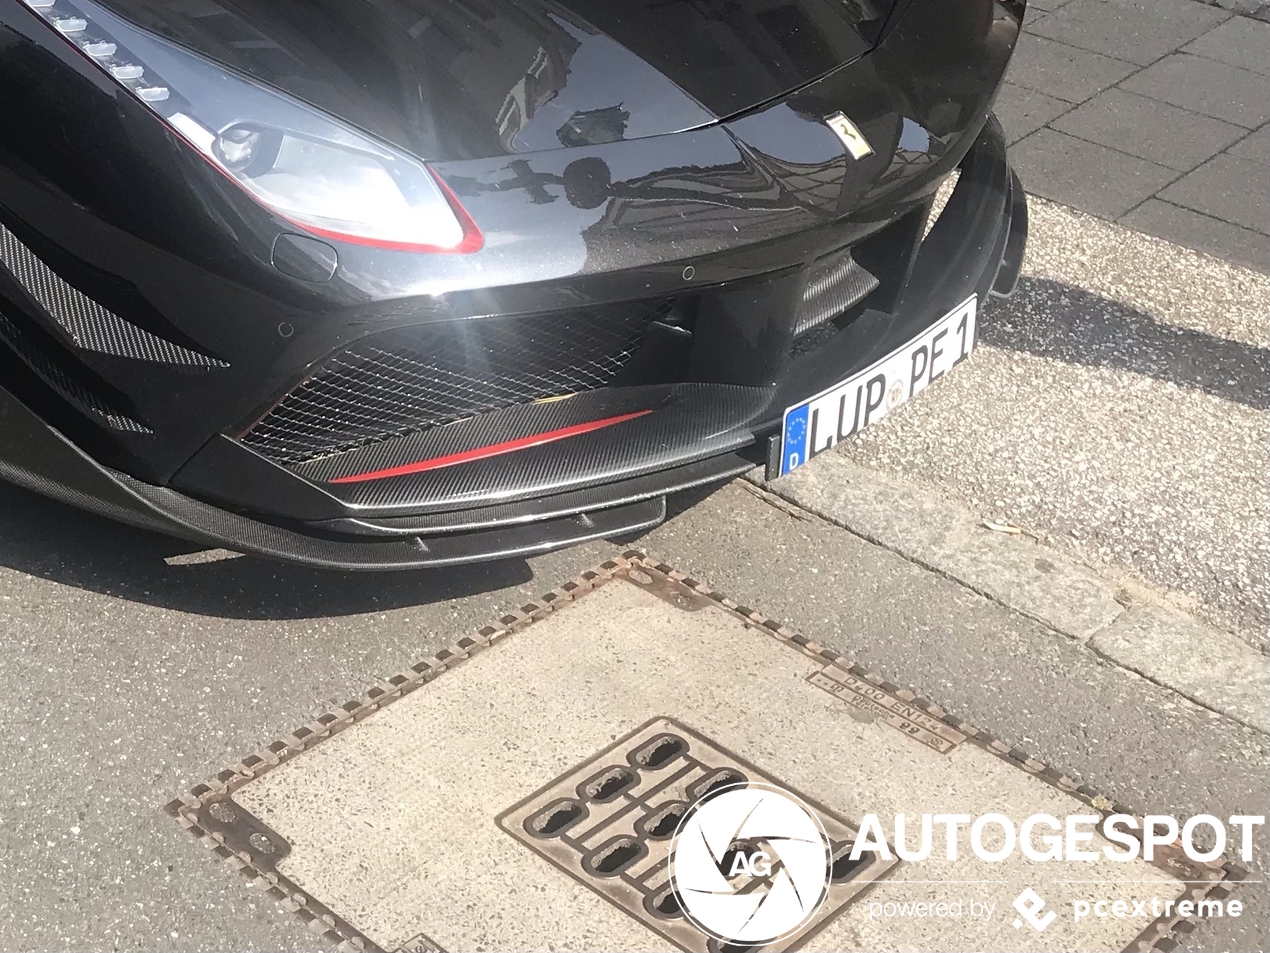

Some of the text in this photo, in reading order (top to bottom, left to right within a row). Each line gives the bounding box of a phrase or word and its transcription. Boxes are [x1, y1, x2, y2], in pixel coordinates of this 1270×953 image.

[809, 312, 969, 459] LUP PE 1
[788, 452, 799, 471] D
